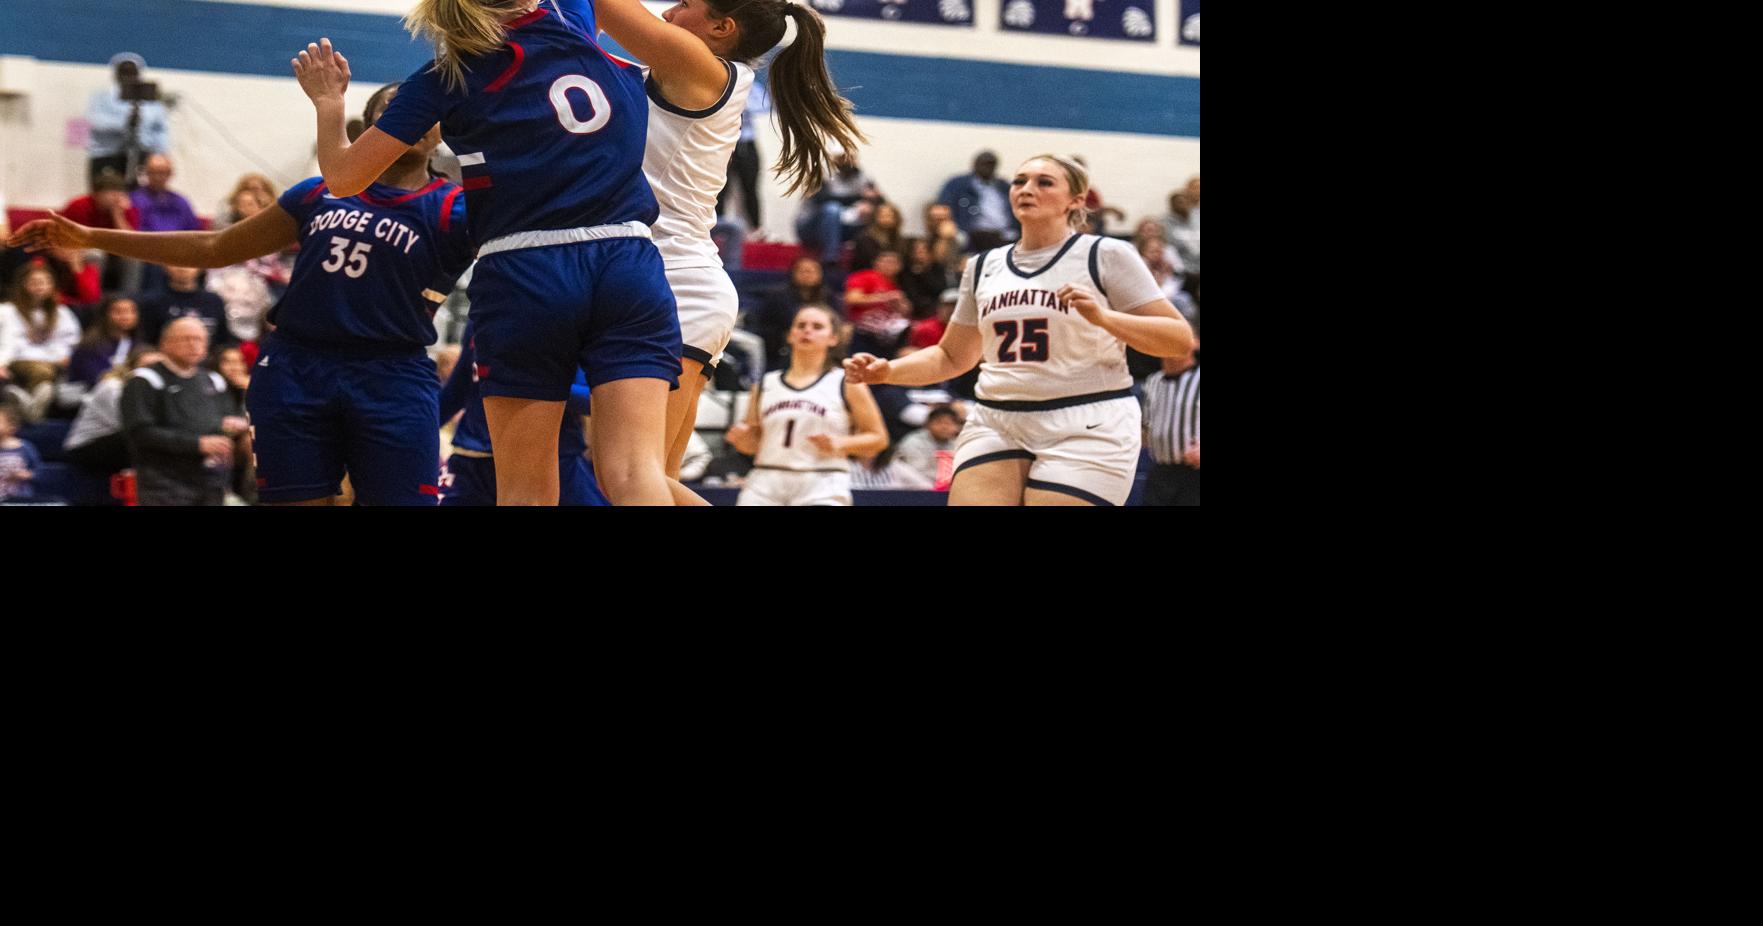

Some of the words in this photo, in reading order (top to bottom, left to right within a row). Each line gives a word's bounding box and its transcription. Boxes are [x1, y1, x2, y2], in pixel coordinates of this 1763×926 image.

[548, 74, 611, 134] 0
[308, 208, 374, 236] DODGE
[374, 218, 420, 254] CITY
[321, 235, 373, 278] 35
[992, 317, 1049, 363] 25
[783, 418, 796, 448] 1
